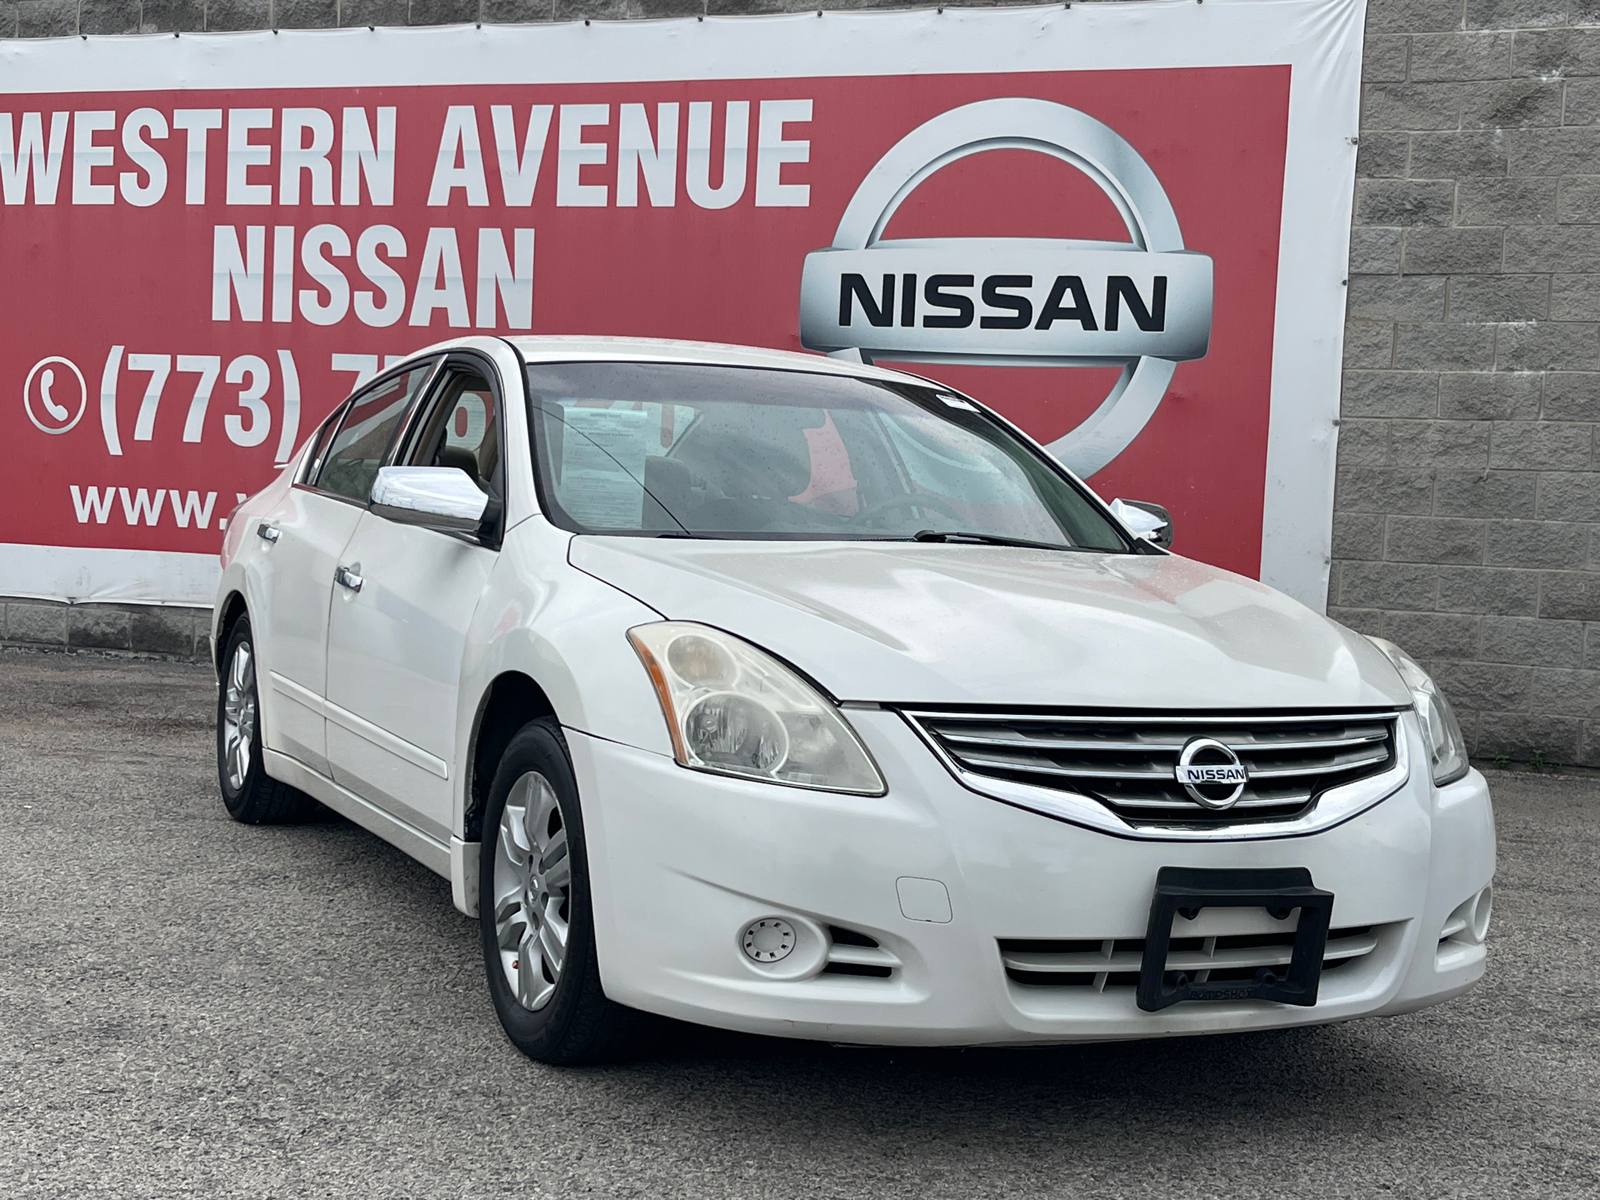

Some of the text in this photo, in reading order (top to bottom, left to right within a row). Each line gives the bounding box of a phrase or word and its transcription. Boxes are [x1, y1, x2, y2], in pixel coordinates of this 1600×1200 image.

[0, 99, 814, 209] WESTERN AVENUE
[211, 224, 535, 329] NISSAN
[838, 273, 1168, 331] NISSAN
[101, 345, 300, 462] (773)
[69, 485, 247, 530] www.
[1186, 769, 1245, 780] NISSAN
